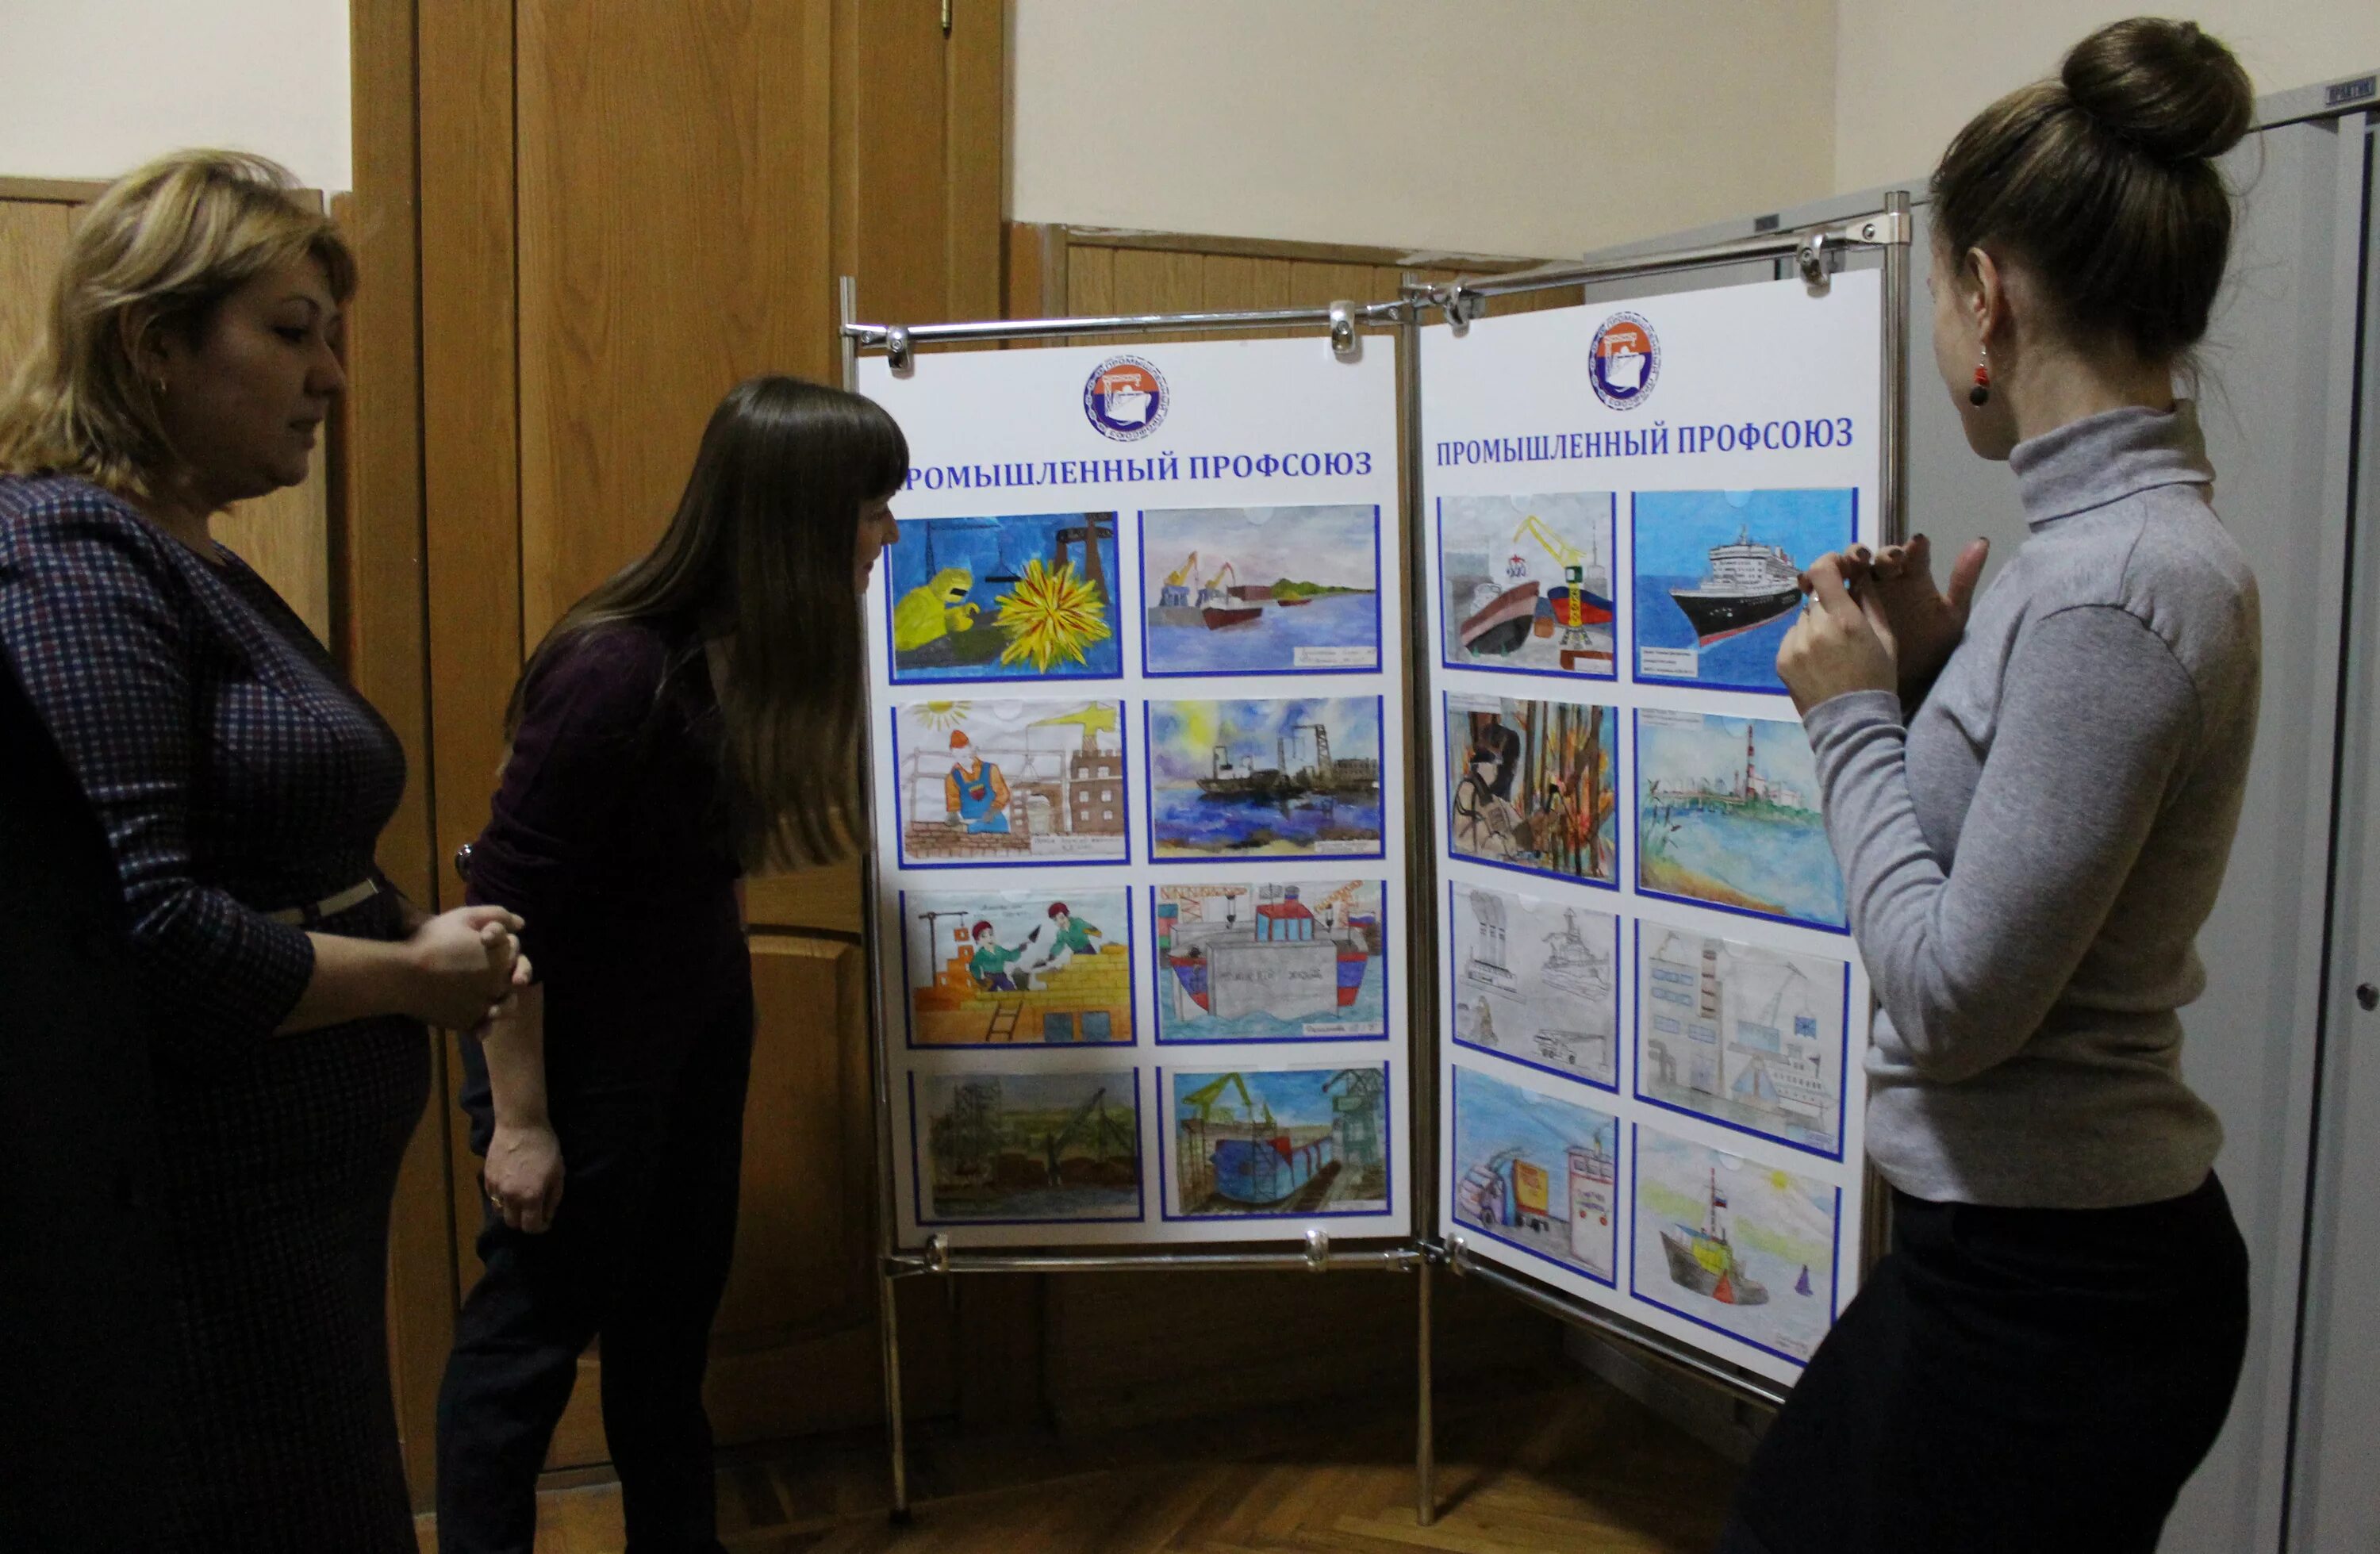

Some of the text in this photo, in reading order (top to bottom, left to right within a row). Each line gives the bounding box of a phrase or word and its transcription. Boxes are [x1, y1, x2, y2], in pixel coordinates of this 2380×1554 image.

[1437, 417, 1853, 466] ПРОМЫШЛЕННЫЙ ПРОФСОЮЗ
[901, 450, 1372, 491] РОМЫШЛЕННЫЙ ПРОФСОЮЗ
